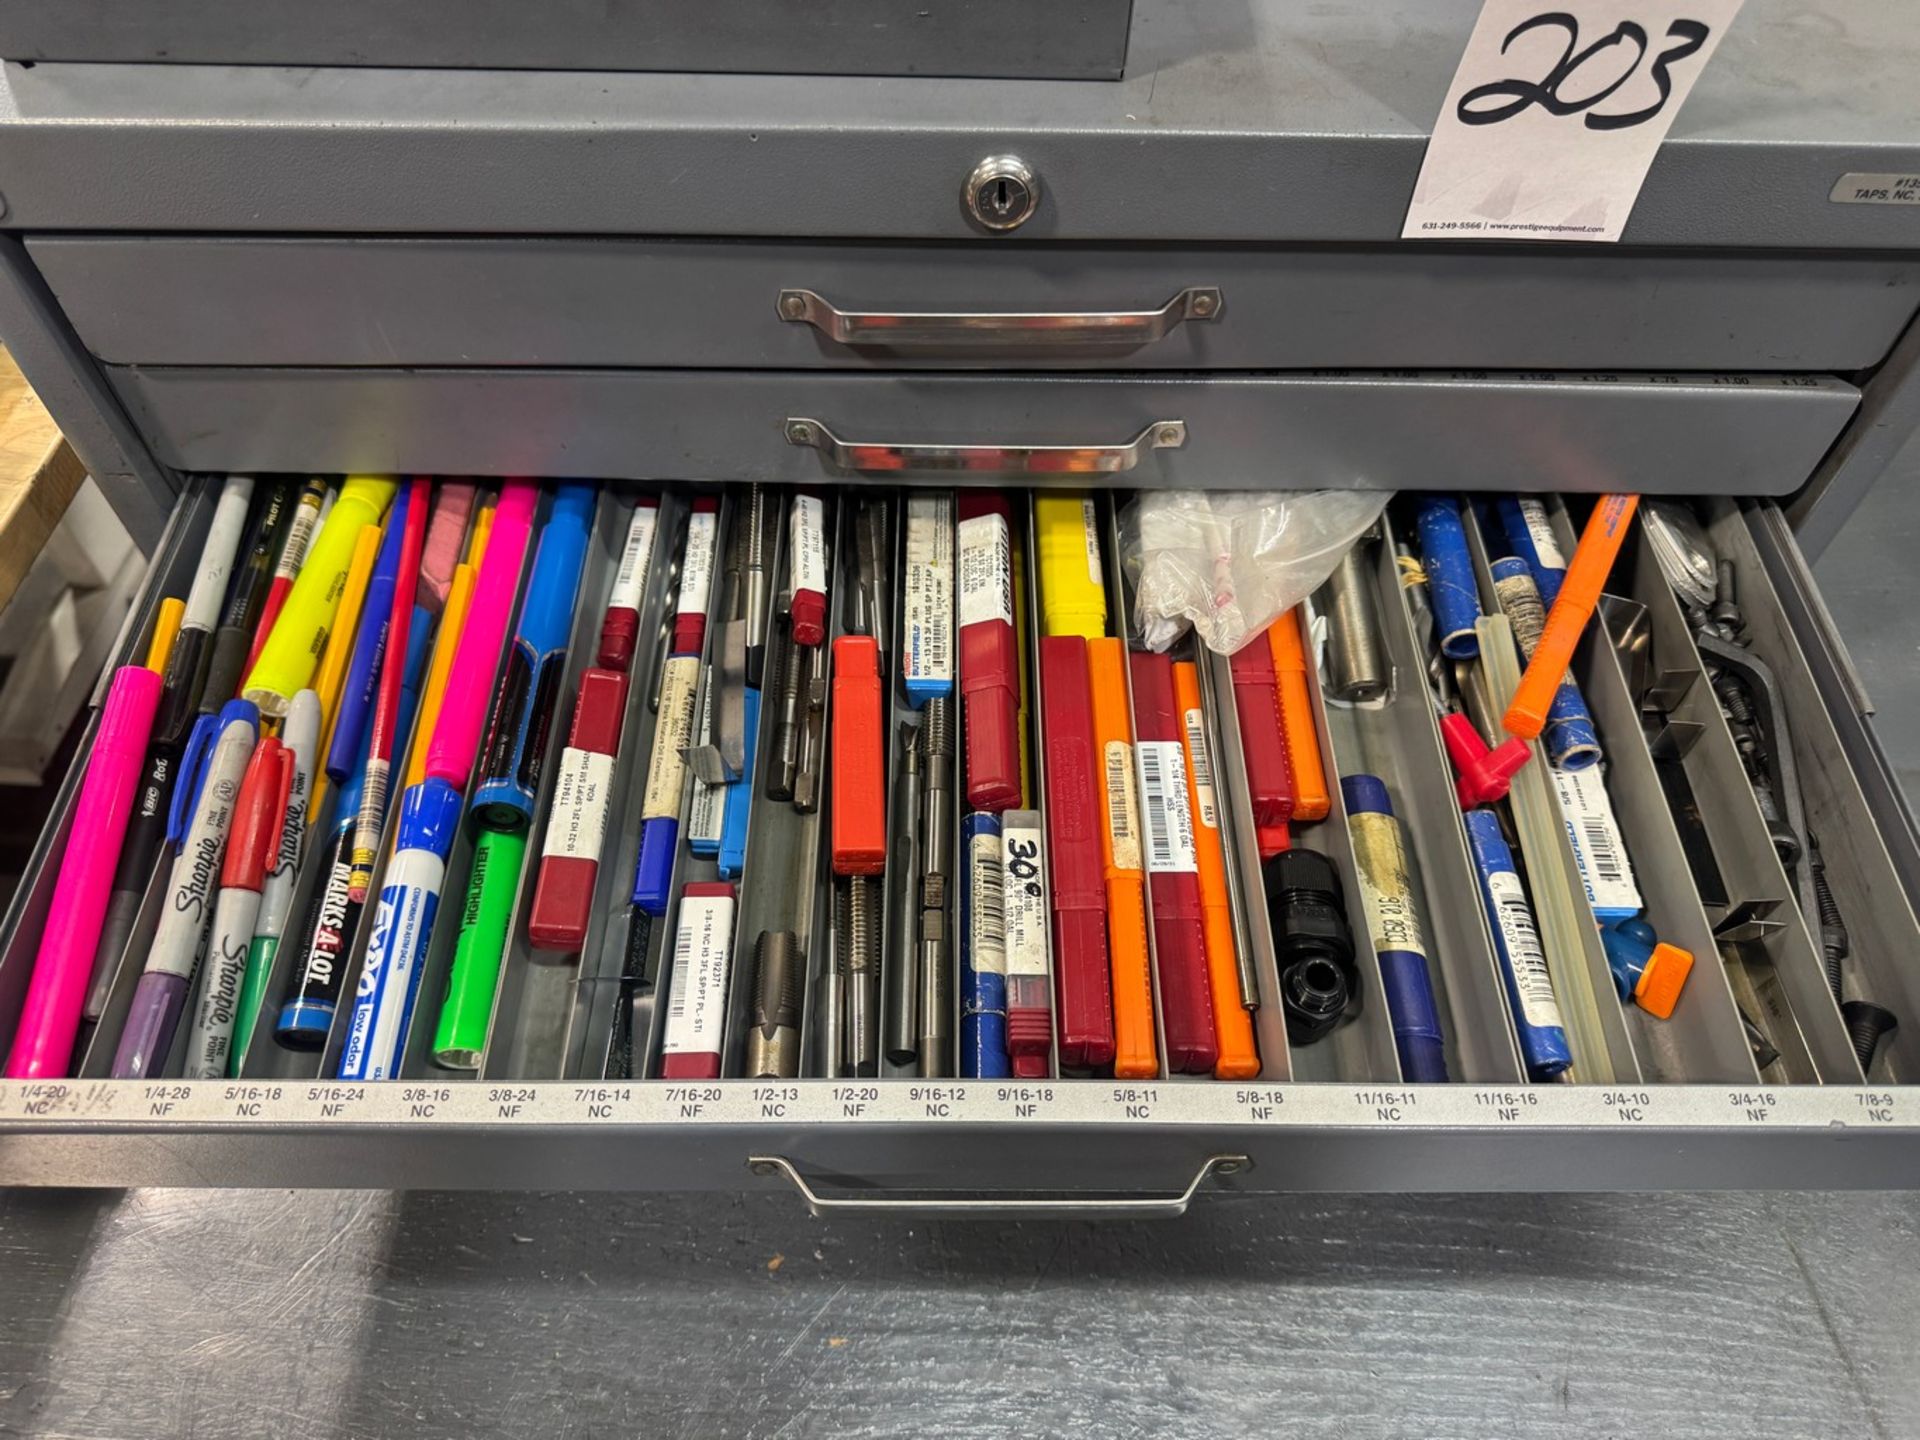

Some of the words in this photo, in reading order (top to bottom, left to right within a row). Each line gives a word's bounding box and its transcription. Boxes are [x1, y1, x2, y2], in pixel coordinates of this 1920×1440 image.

[1457, 12, 1710, 130] 203
[1854, 189, 1889, 201] TAPS,
[1421, 222, 1482, 230] 631-249-5566
[1489, 223, 1605, 234] www.prestigeequipment.com
[265, 502, 280, 526] PILOT
[999, 527, 1010, 576] TITAN
[1001, 578, 1011, 615] USA
[910, 624, 921, 675] BUTTERFIELD
[221, 782, 232, 799] AP
[142, 787, 159, 810] BIC
[1560, 790, 1571, 805] 5/8
[216, 806, 229, 829] POINT
[176, 837, 220, 924] Sharpie
[466, 847, 489, 925] HIGHLIGHTER
[971, 864, 982, 897] 62609
[409, 887, 421, 920] CONFORMS
[1014, 904, 1024, 926] DRILL
[405, 920, 414, 929] TO
[1014, 928, 1024, 947] MILL
[1498, 905, 1517, 944] 62609
[1511, 950, 1531, 991] 55533
[710, 949, 724, 988] TT92371
[207, 932, 250, 1028] Sharpie
[353, 1006, 370, 1033] low
[204, 1035, 218, 1062] POINT
[216, 1036, 227, 1056] FINE
[345, 1035, 364, 1070] odor
[20, 1086, 66, 1098] 1/4-20
[144, 1087, 191, 1099] 1/4-28
[224, 1088, 281, 1100] 5/16-18
[307, 1088, 365, 1101] 5/16-24
[402, 1089, 450, 1102] 3/8-16
[489, 1089, 536, 1102] 3/8-24
[574, 1089, 630, 1101] 7/16-14
[665, 1089, 722, 1101] 7/16-20
[752, 1088, 798, 1100] 1/2-13
[832, 1088, 879, 1100] 1/2-20
[910, 1088, 966, 1101] 9/16-12
[997, 1088, 1053, 1101] 9/16-18
[1113, 1090, 1158, 1102] 5/8-11
[1237, 1091, 1284, 1103] 5/8-18
[1354, 1093, 1417, 1105] 11/16-11
[1474, 1093, 1538, 1105] 11/16-16
[1602, 1093, 1650, 1105] 3/4-10
[1728, 1094, 1776, 1106] 3/4-16
[1855, 1094, 1894, 1106] 7/8-9
[24, 1104, 48, 1115] NC
[150, 1104, 173, 1116] NF
[236, 1104, 261, 1116] NC
[320, 1104, 344, 1117] NF
[410, 1105, 435, 1117] NC
[498, 1105, 522, 1117] NF
[587, 1105, 612, 1118] NC
[680, 1105, 704, 1118] NF
[761, 1105, 786, 1118] NC
[843, 1104, 866, 1117] NF
[926, 1104, 950, 1117] NC
[1015, 1104, 1038, 1117] NF
[1125, 1106, 1150, 1118] NC
[1251, 1107, 1274, 1119] NF
[1377, 1108, 1401, 1121] NC
[1497, 1108, 1521, 1121] NF
[1619, 1108, 1643, 1121] NC
[1746, 1109, 1768, 1121] NF
[1868, 1109, 1893, 1122] NC
